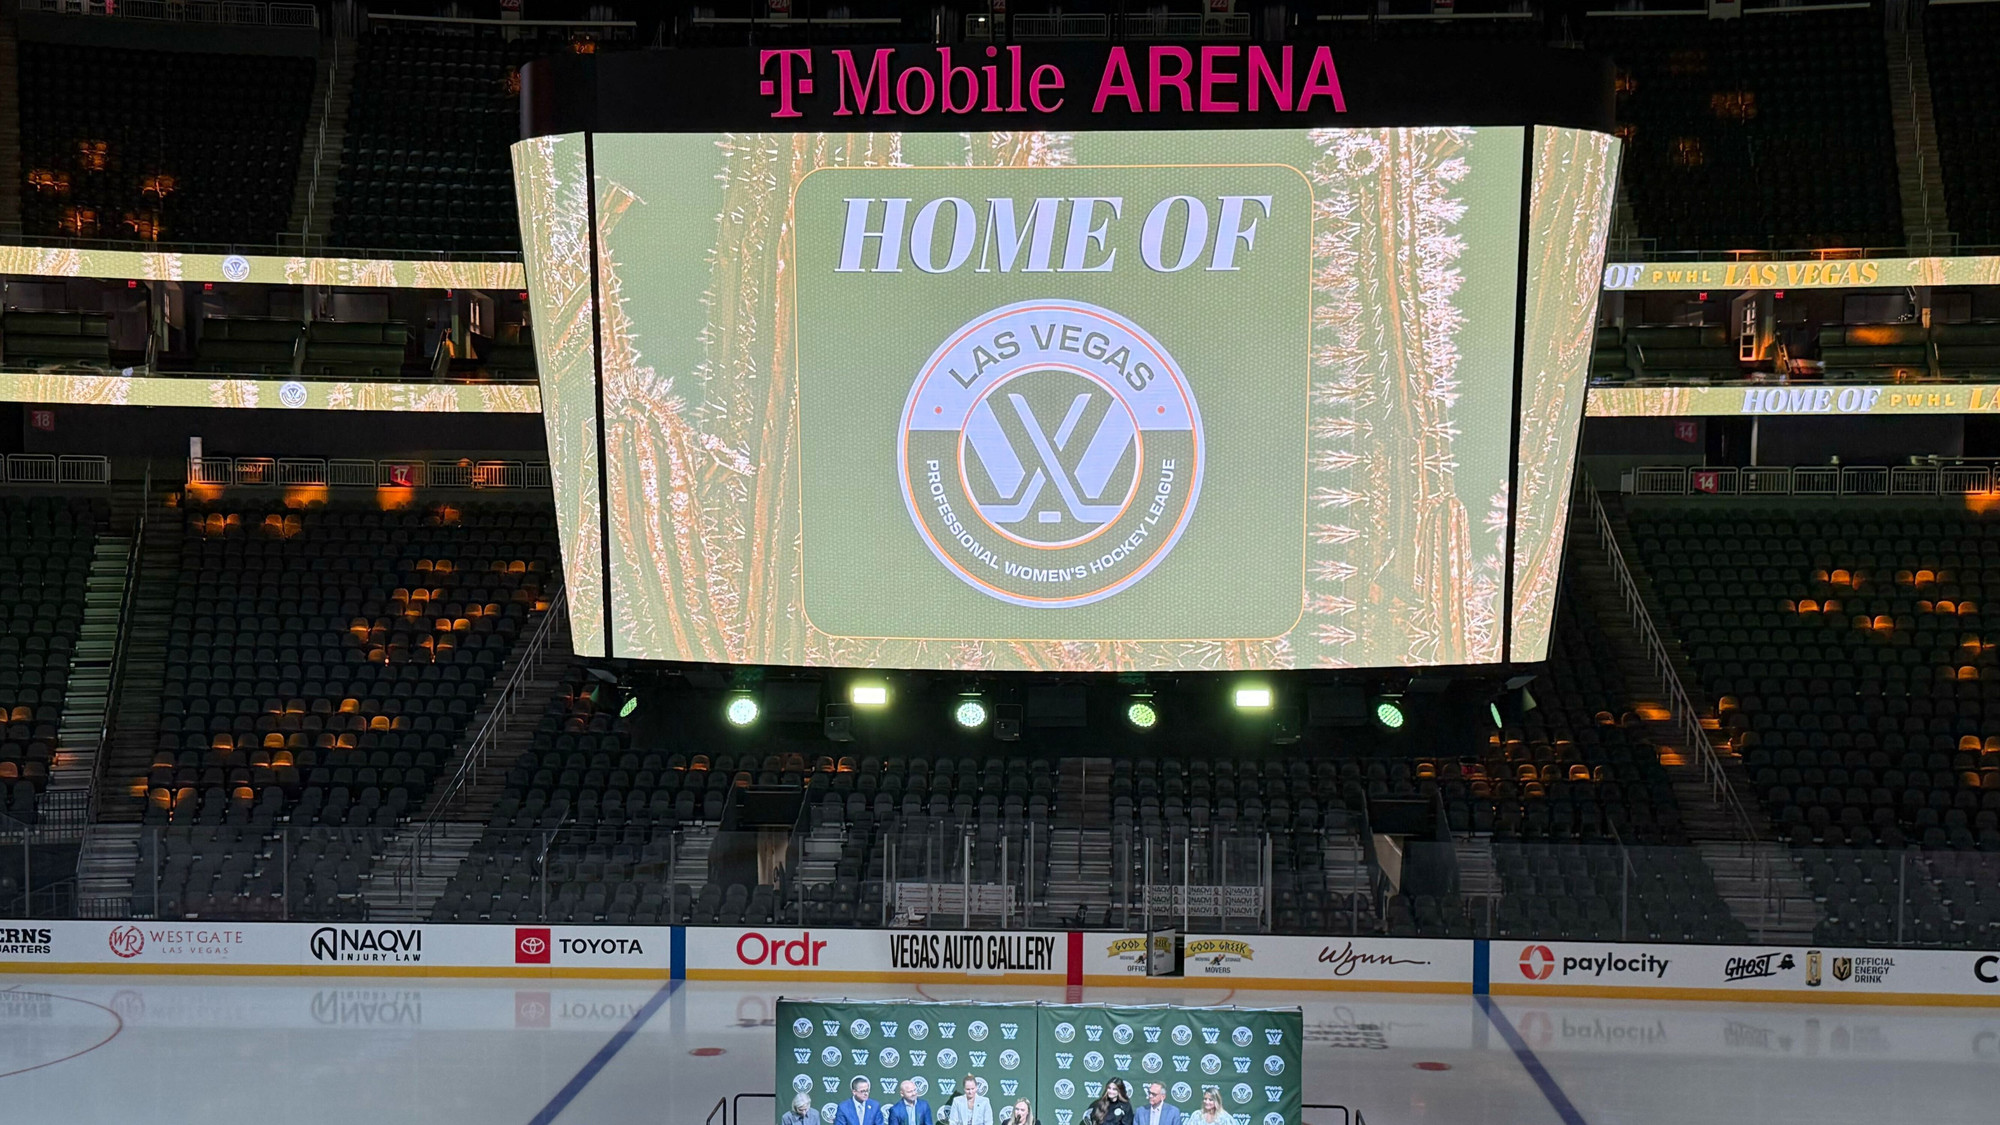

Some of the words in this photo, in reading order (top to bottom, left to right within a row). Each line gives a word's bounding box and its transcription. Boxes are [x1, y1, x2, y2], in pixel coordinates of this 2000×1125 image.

[832, 46, 1065, 116] Mobile
[1091, 45, 1347, 112] ARENA
[833, 195, 1124, 274] HOME
[1139, 195, 1273, 273] OF
[1604, 264, 1644, 288] OF
[1653, 271, 1711, 283] PWHL
[1723, 263, 1779, 287] LAS
[1786, 261, 1879, 286] VEGAS
[948, 330, 1021, 391] LAS
[1030, 323, 1155, 392] VEGAS
[1741, 387, 1835, 413] HOME
[1837, 387, 1882, 412] OF
[1890, 394, 1956, 407] PWHL
[36, 413, 50, 427] 18
[1679, 425, 1693, 439] 14
[394, 468, 409, 482] 17
[1698, 475, 1714, 490] 14
[926, 457, 1000, 571] PROFESSIONAL
[1003, 561, 1087, 583] WOMEN'S
[1089, 529, 1149, 580] HOCKEY
[1148, 457, 1176, 526] LEAGUE
[149, 930, 243, 943] WESTGATE
[341, 929, 421, 953] NAQVI
[0, 945, 51, 954] ARTERS
[162, 946, 183, 954] LAS
[190, 946, 229, 954] VEGAS
[559, 938, 643, 955] TOYOTA
[736, 931, 827, 966] Ordr
[1115, 939, 1140, 951] GOOD
[1190, 941, 1216, 952] GOOD
[1219, 941, 1248, 954] GREEK
[341, 953, 387, 961] INJURY
[395, 953, 421, 961] LAW
[889, 934, 940, 969] VEGAS
[942, 934, 984, 969] AUTO
[987, 935, 1056, 971] GALLERY
[1563, 952, 1669, 978] paylocity
[1724, 952, 1782, 982] GHOST
[1855, 957, 1896, 966] OFFICIAL
[1205, 966, 1231, 974] MOVERS
[1854, 966, 1890, 975] ENERGY
[1854, 974, 1882, 984] DRINK
